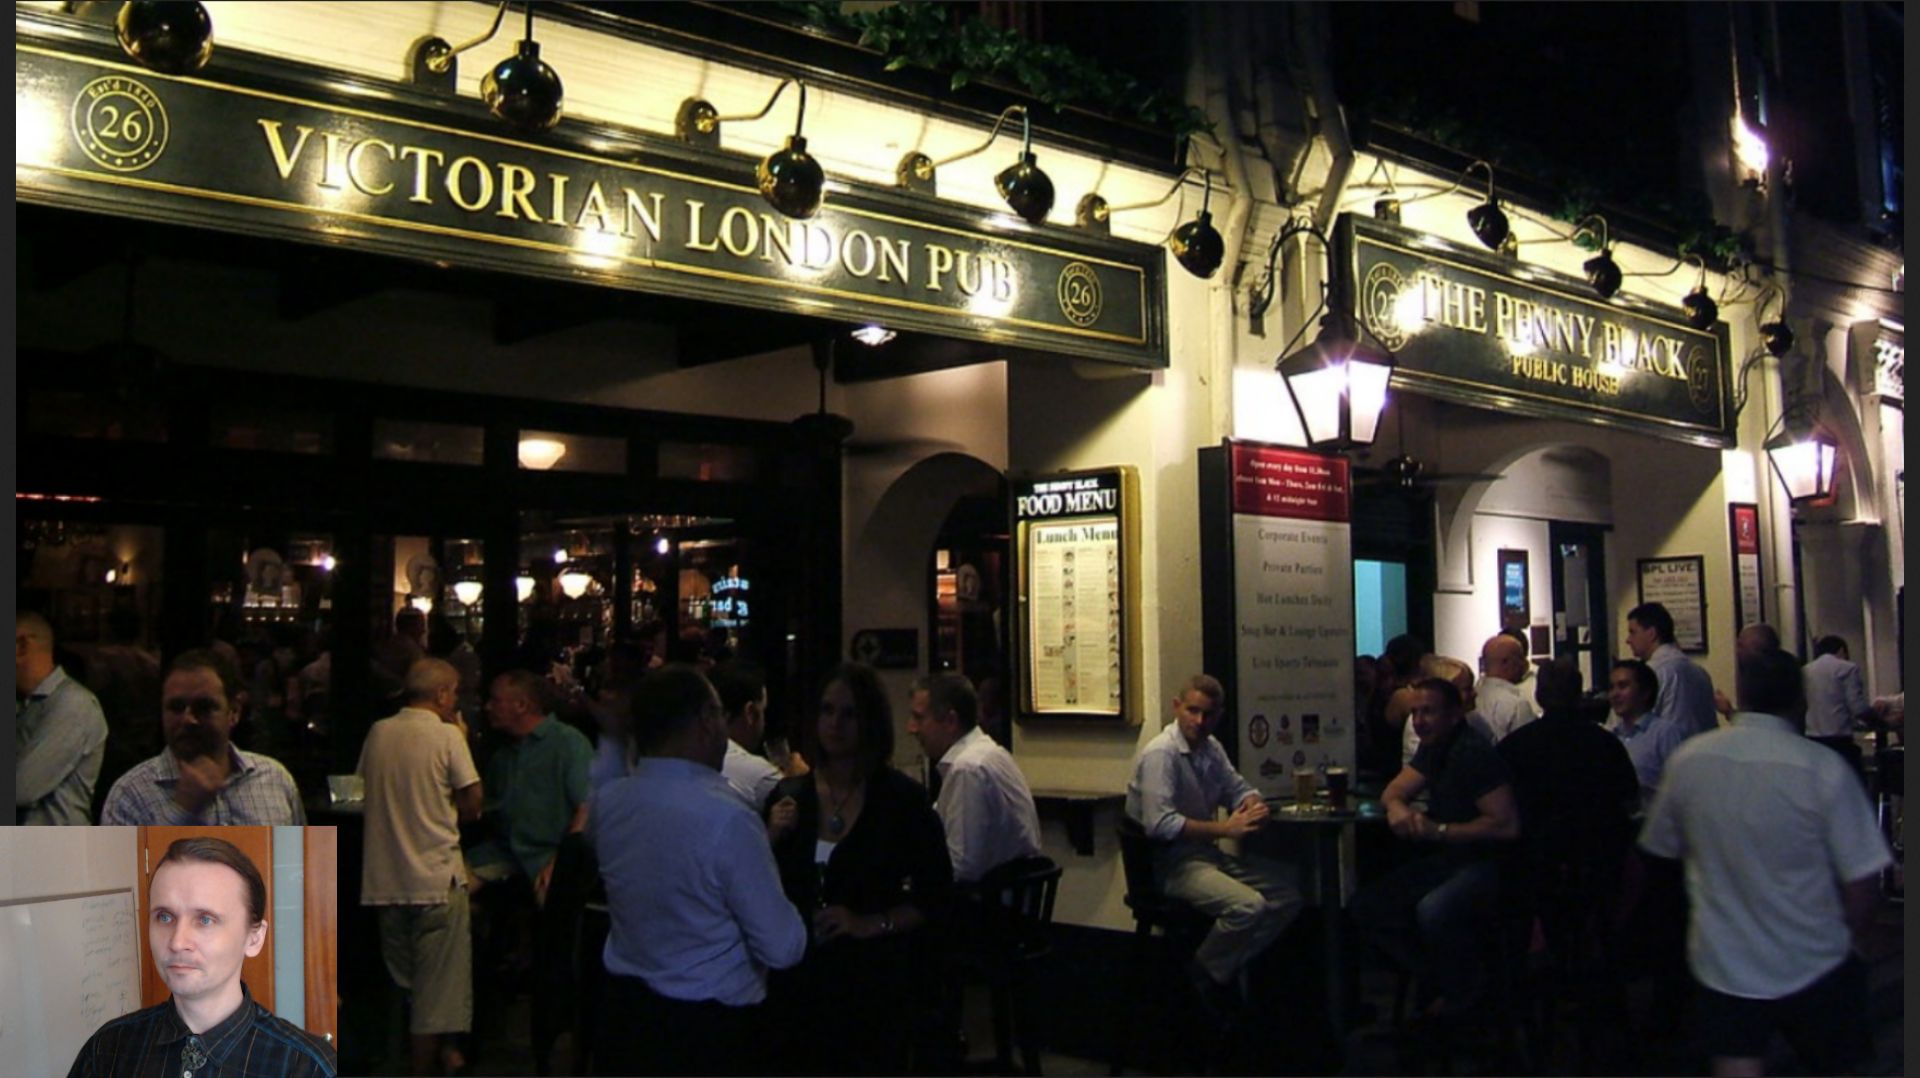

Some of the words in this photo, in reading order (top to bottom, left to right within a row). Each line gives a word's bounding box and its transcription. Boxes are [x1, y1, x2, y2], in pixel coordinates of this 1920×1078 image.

[99, 105, 142, 142] 26
[257, 118, 666, 243] VICTORIAN
[685, 199, 911, 285] LONDON
[925, 243, 1017, 304] PUB
[1070, 281, 1091, 306] 26
[1418, 274, 1488, 335] THE
[1494, 291, 1596, 359] PENNY
[1602, 321, 1688, 381] BLACK
[1511, 354, 1568, 385] PUBLIC
[1571, 364, 1620, 395] HOUSE
[1017, 494, 1062, 516] FOOD
[1064, 488, 1117, 513] MENU
[1037, 529, 1077, 544] Lunch
[1082, 527, 1118, 541] Menu
[1667, 562, 1693, 573] LIVE
